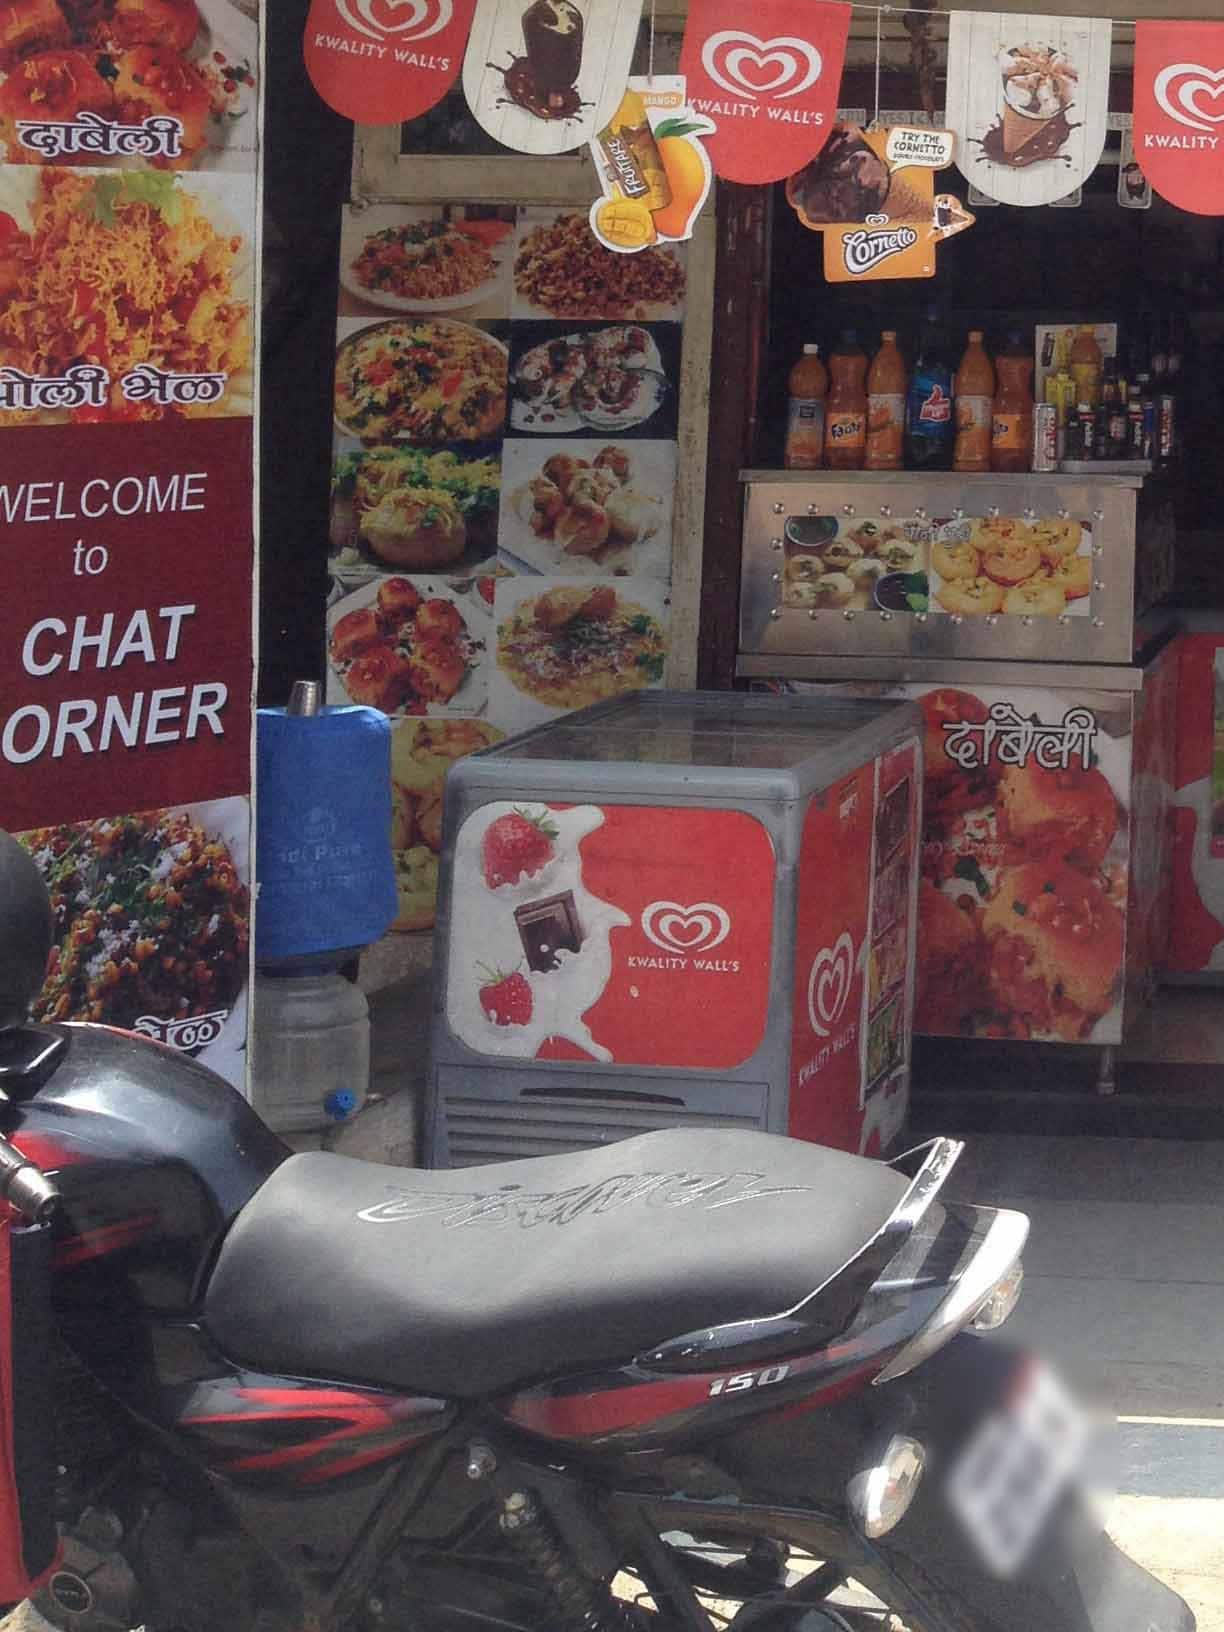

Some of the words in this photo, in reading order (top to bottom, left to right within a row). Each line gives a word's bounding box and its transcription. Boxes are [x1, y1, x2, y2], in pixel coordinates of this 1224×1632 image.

[314, 33, 386, 59] KWALITY
[393, 47, 450, 72] WALL'S
[16, 112, 184, 157] दाबेली
[767, 108, 824, 126] WALL'S
[893, 142, 945, 155] CORNETTO
[1144, 134, 1219, 150] KWALITY
[842, 226, 918, 274] Cornetto
[121, 364, 228, 405] भेळ
[73, 539, 109, 576] to
[22, 605, 196, 676] CHAT
[1, 682, 228, 765] ORNER
[628, 955, 688, 969] KWALITY
[693, 959, 740, 973] WALL'S
[709, 1365, 791, 1397] 150
